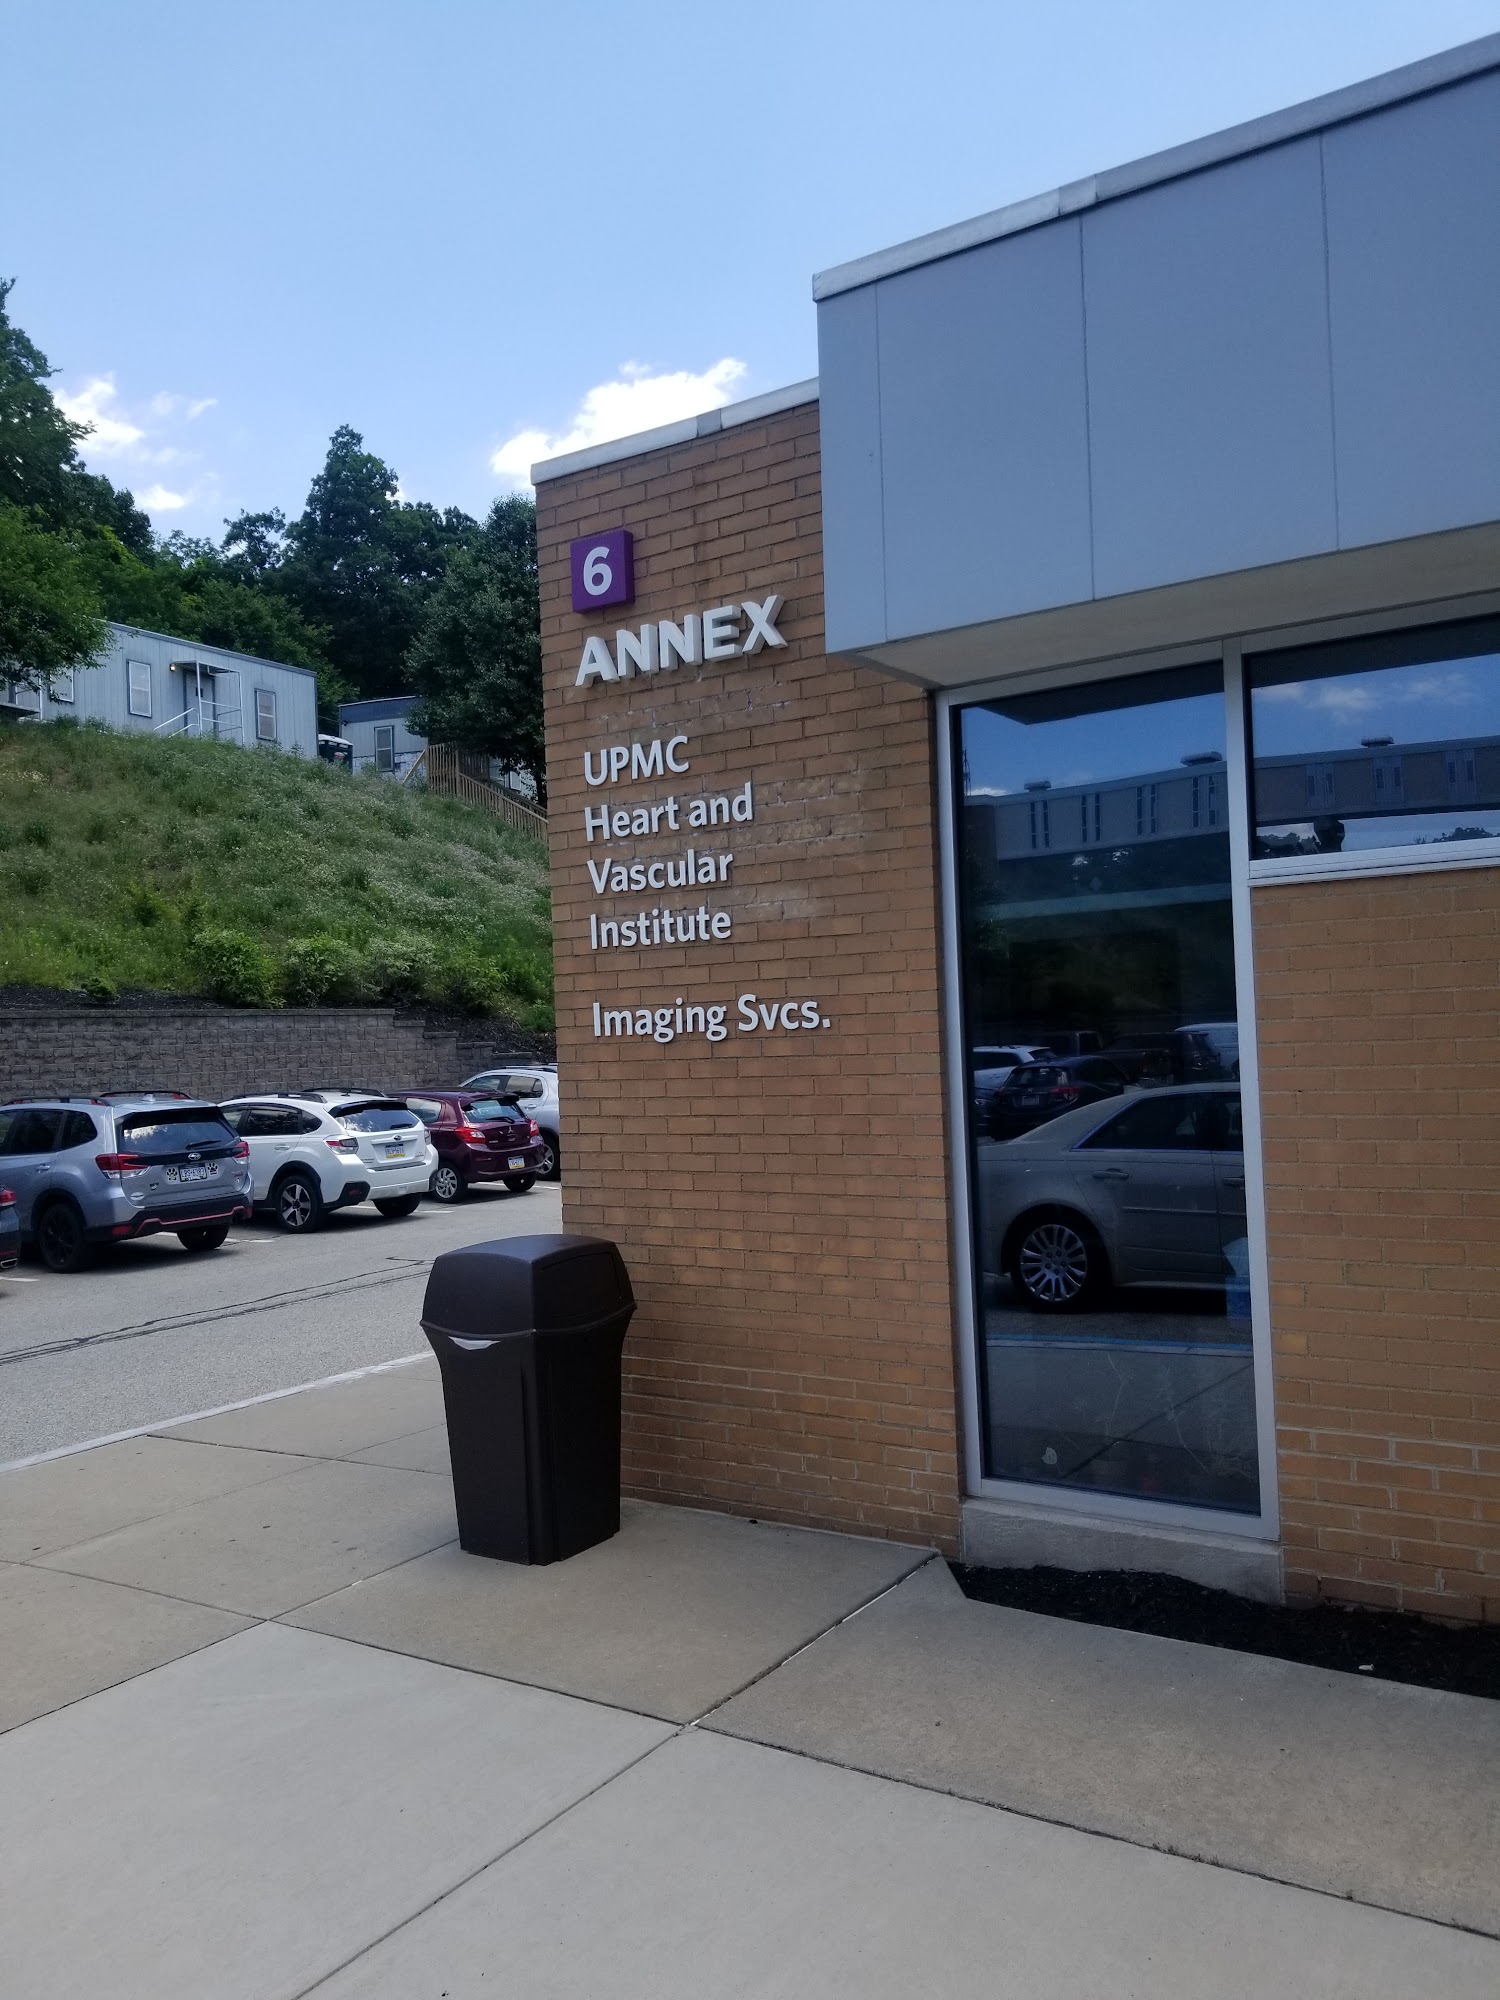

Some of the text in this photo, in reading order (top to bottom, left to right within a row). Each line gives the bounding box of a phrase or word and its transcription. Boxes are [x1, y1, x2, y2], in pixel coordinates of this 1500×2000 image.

[583, 546, 613, 596] 6
[575, 595, 788, 687] ANNEX
[584, 735, 690, 786] UPMC
[585, 782, 753, 842] Heart and
[587, 849, 734, 894] Vascular
[590, 906, 731, 950] Institute
[592, 993, 831, 1043] Imaging Svcs.
